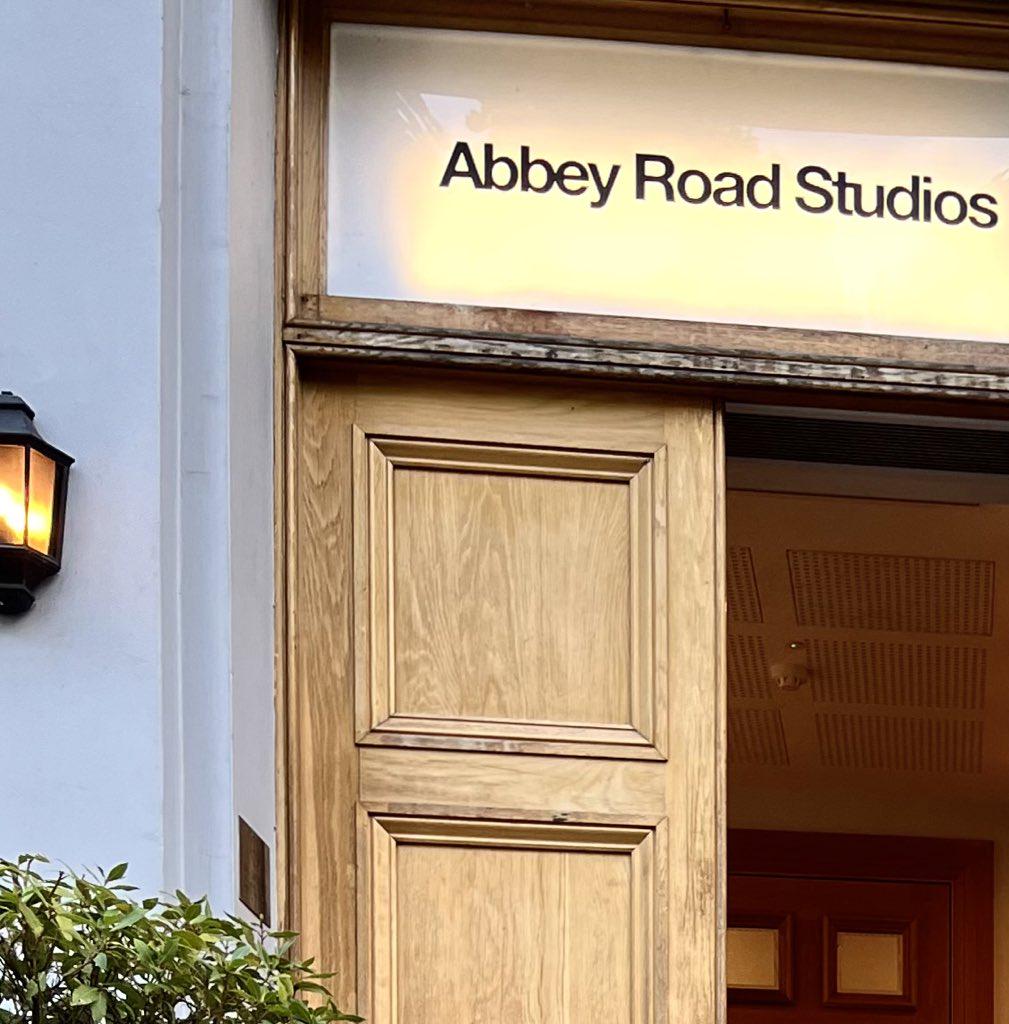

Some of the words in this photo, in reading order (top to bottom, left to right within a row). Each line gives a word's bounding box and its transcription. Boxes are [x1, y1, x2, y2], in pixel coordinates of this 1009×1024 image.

[440, 140, 621, 208] Abbey
[635, 153, 781, 210] Road
[795, 164, 999, 229] Studios
